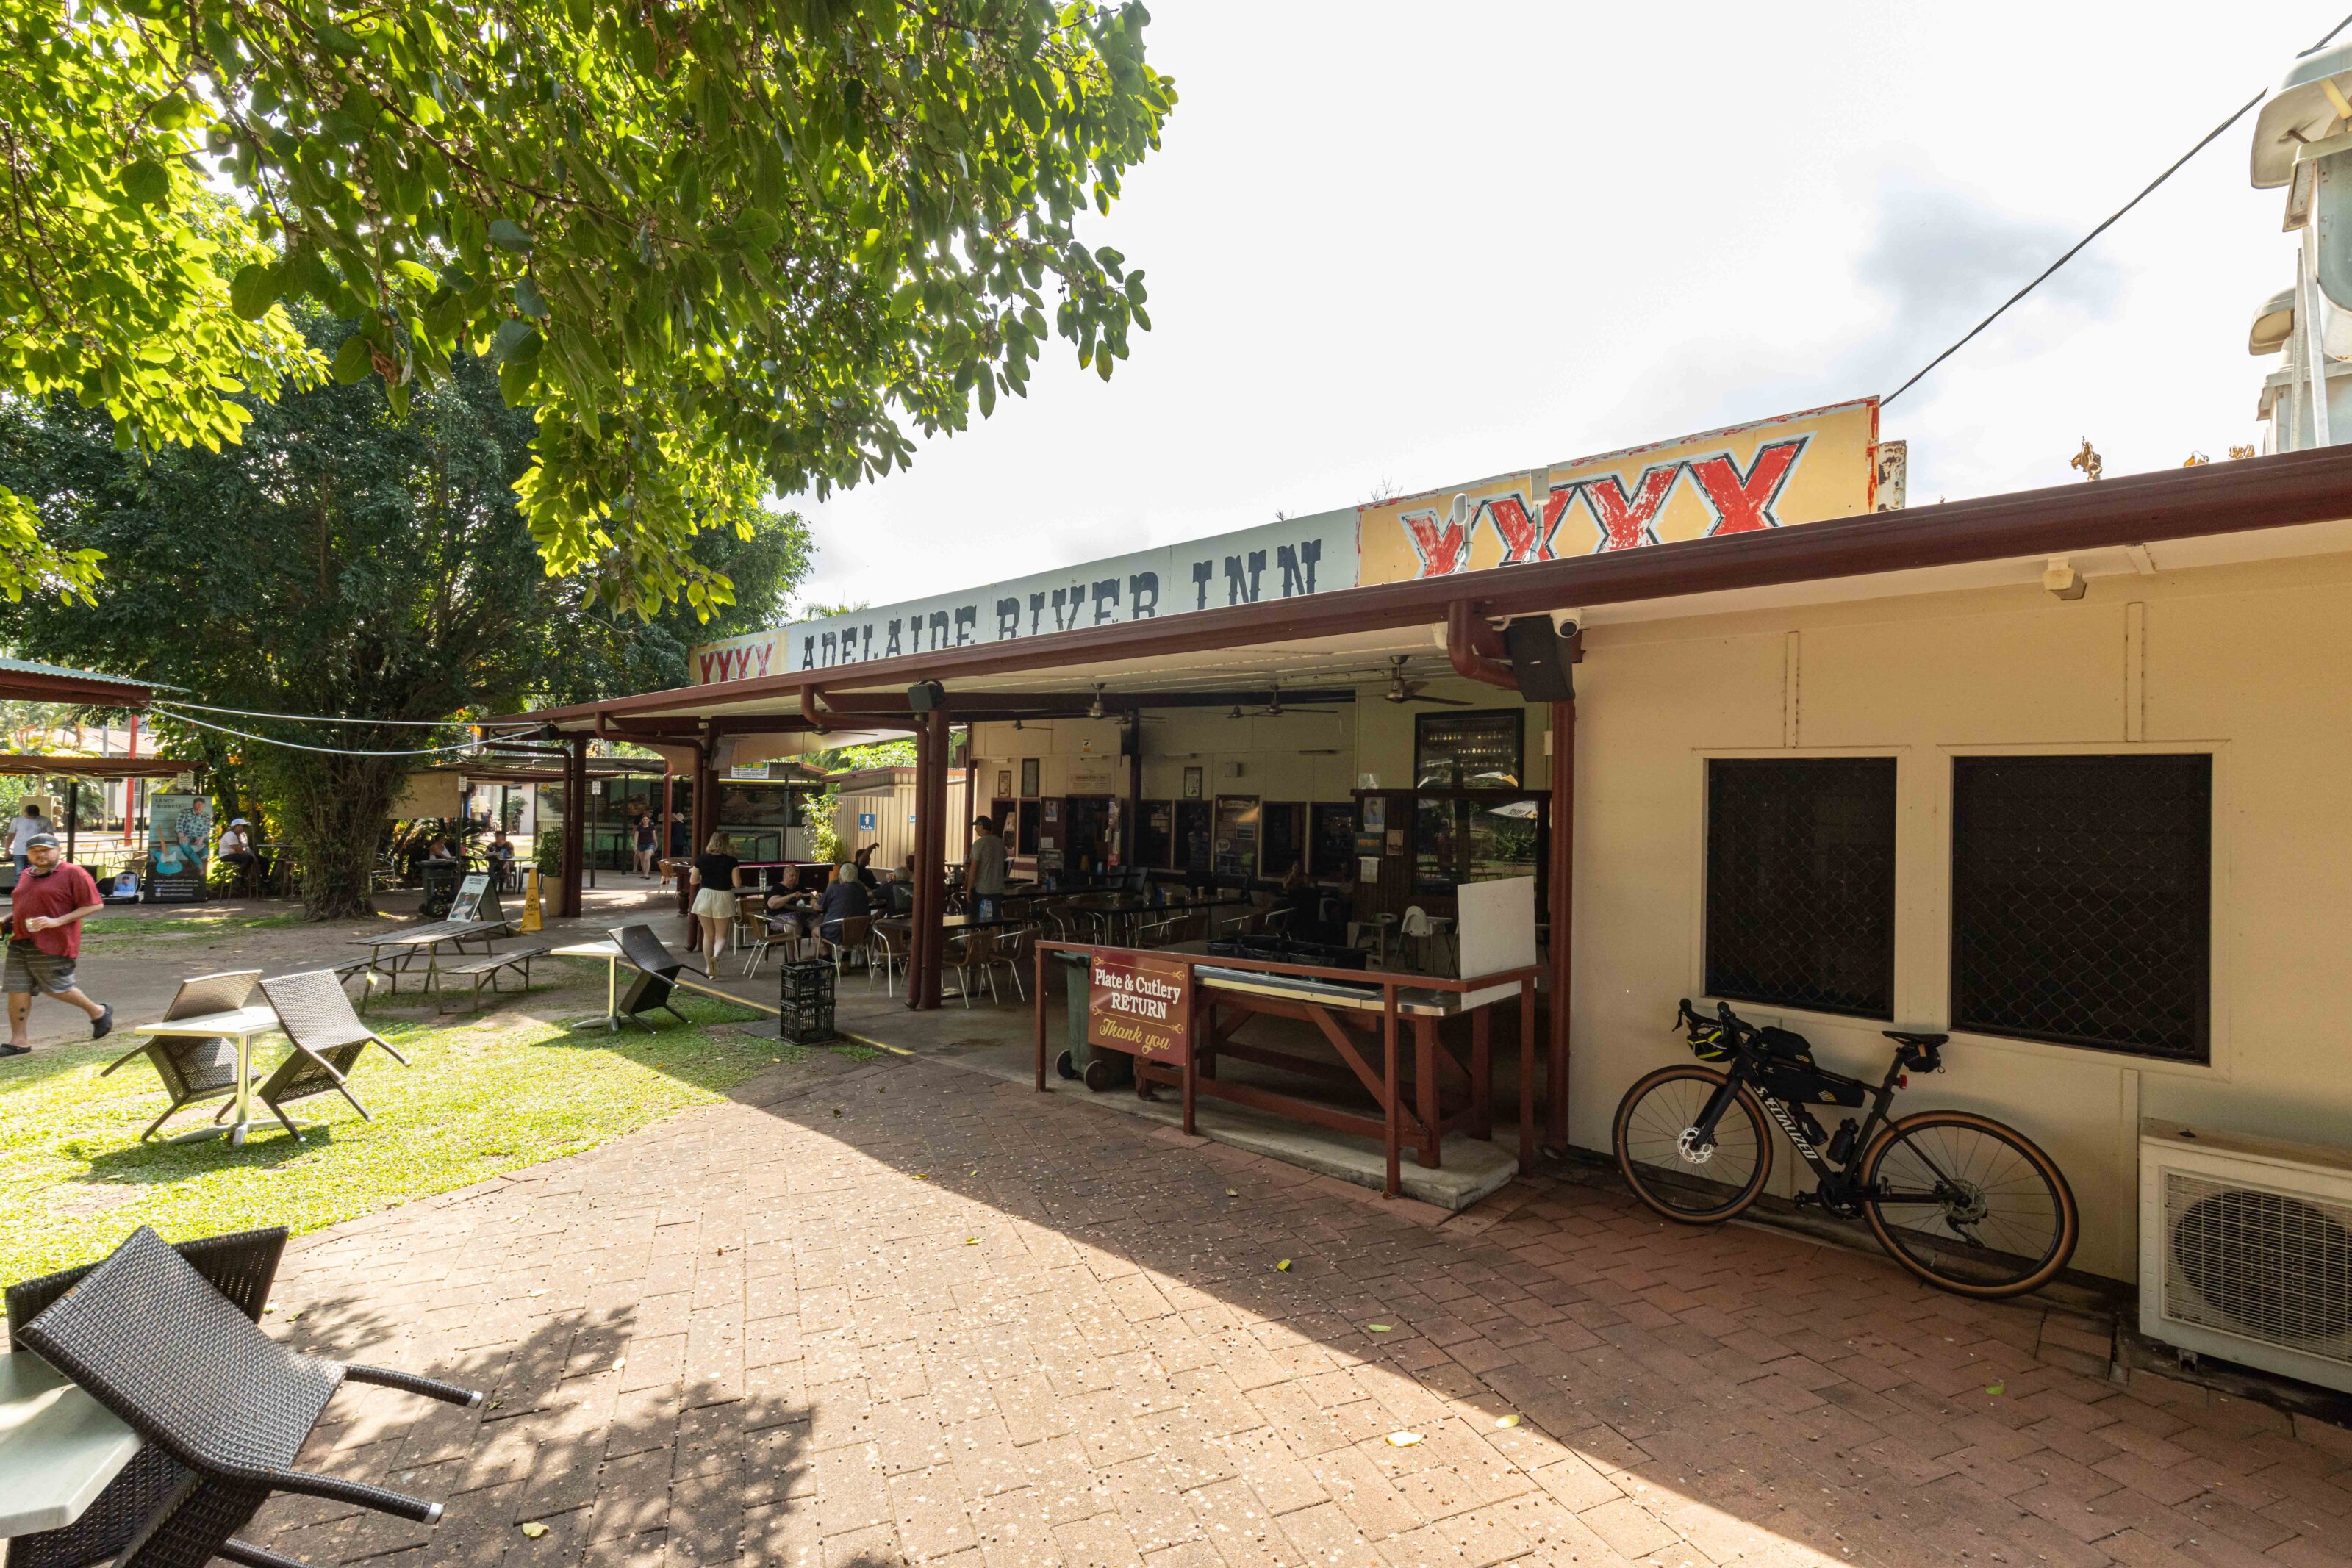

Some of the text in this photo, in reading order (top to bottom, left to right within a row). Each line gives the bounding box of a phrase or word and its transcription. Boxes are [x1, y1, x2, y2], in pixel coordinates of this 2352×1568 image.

[802, 539, 1322, 670] ADELAIDE RIVER INN
[1095, 968, 1182, 1005] Plate & Cutlery
[1111, 992, 1167, 1020] RETURN
[1099, 1018, 1171, 1055] Thank you
[1754, 1087, 1819, 1159] SECIALIZED
